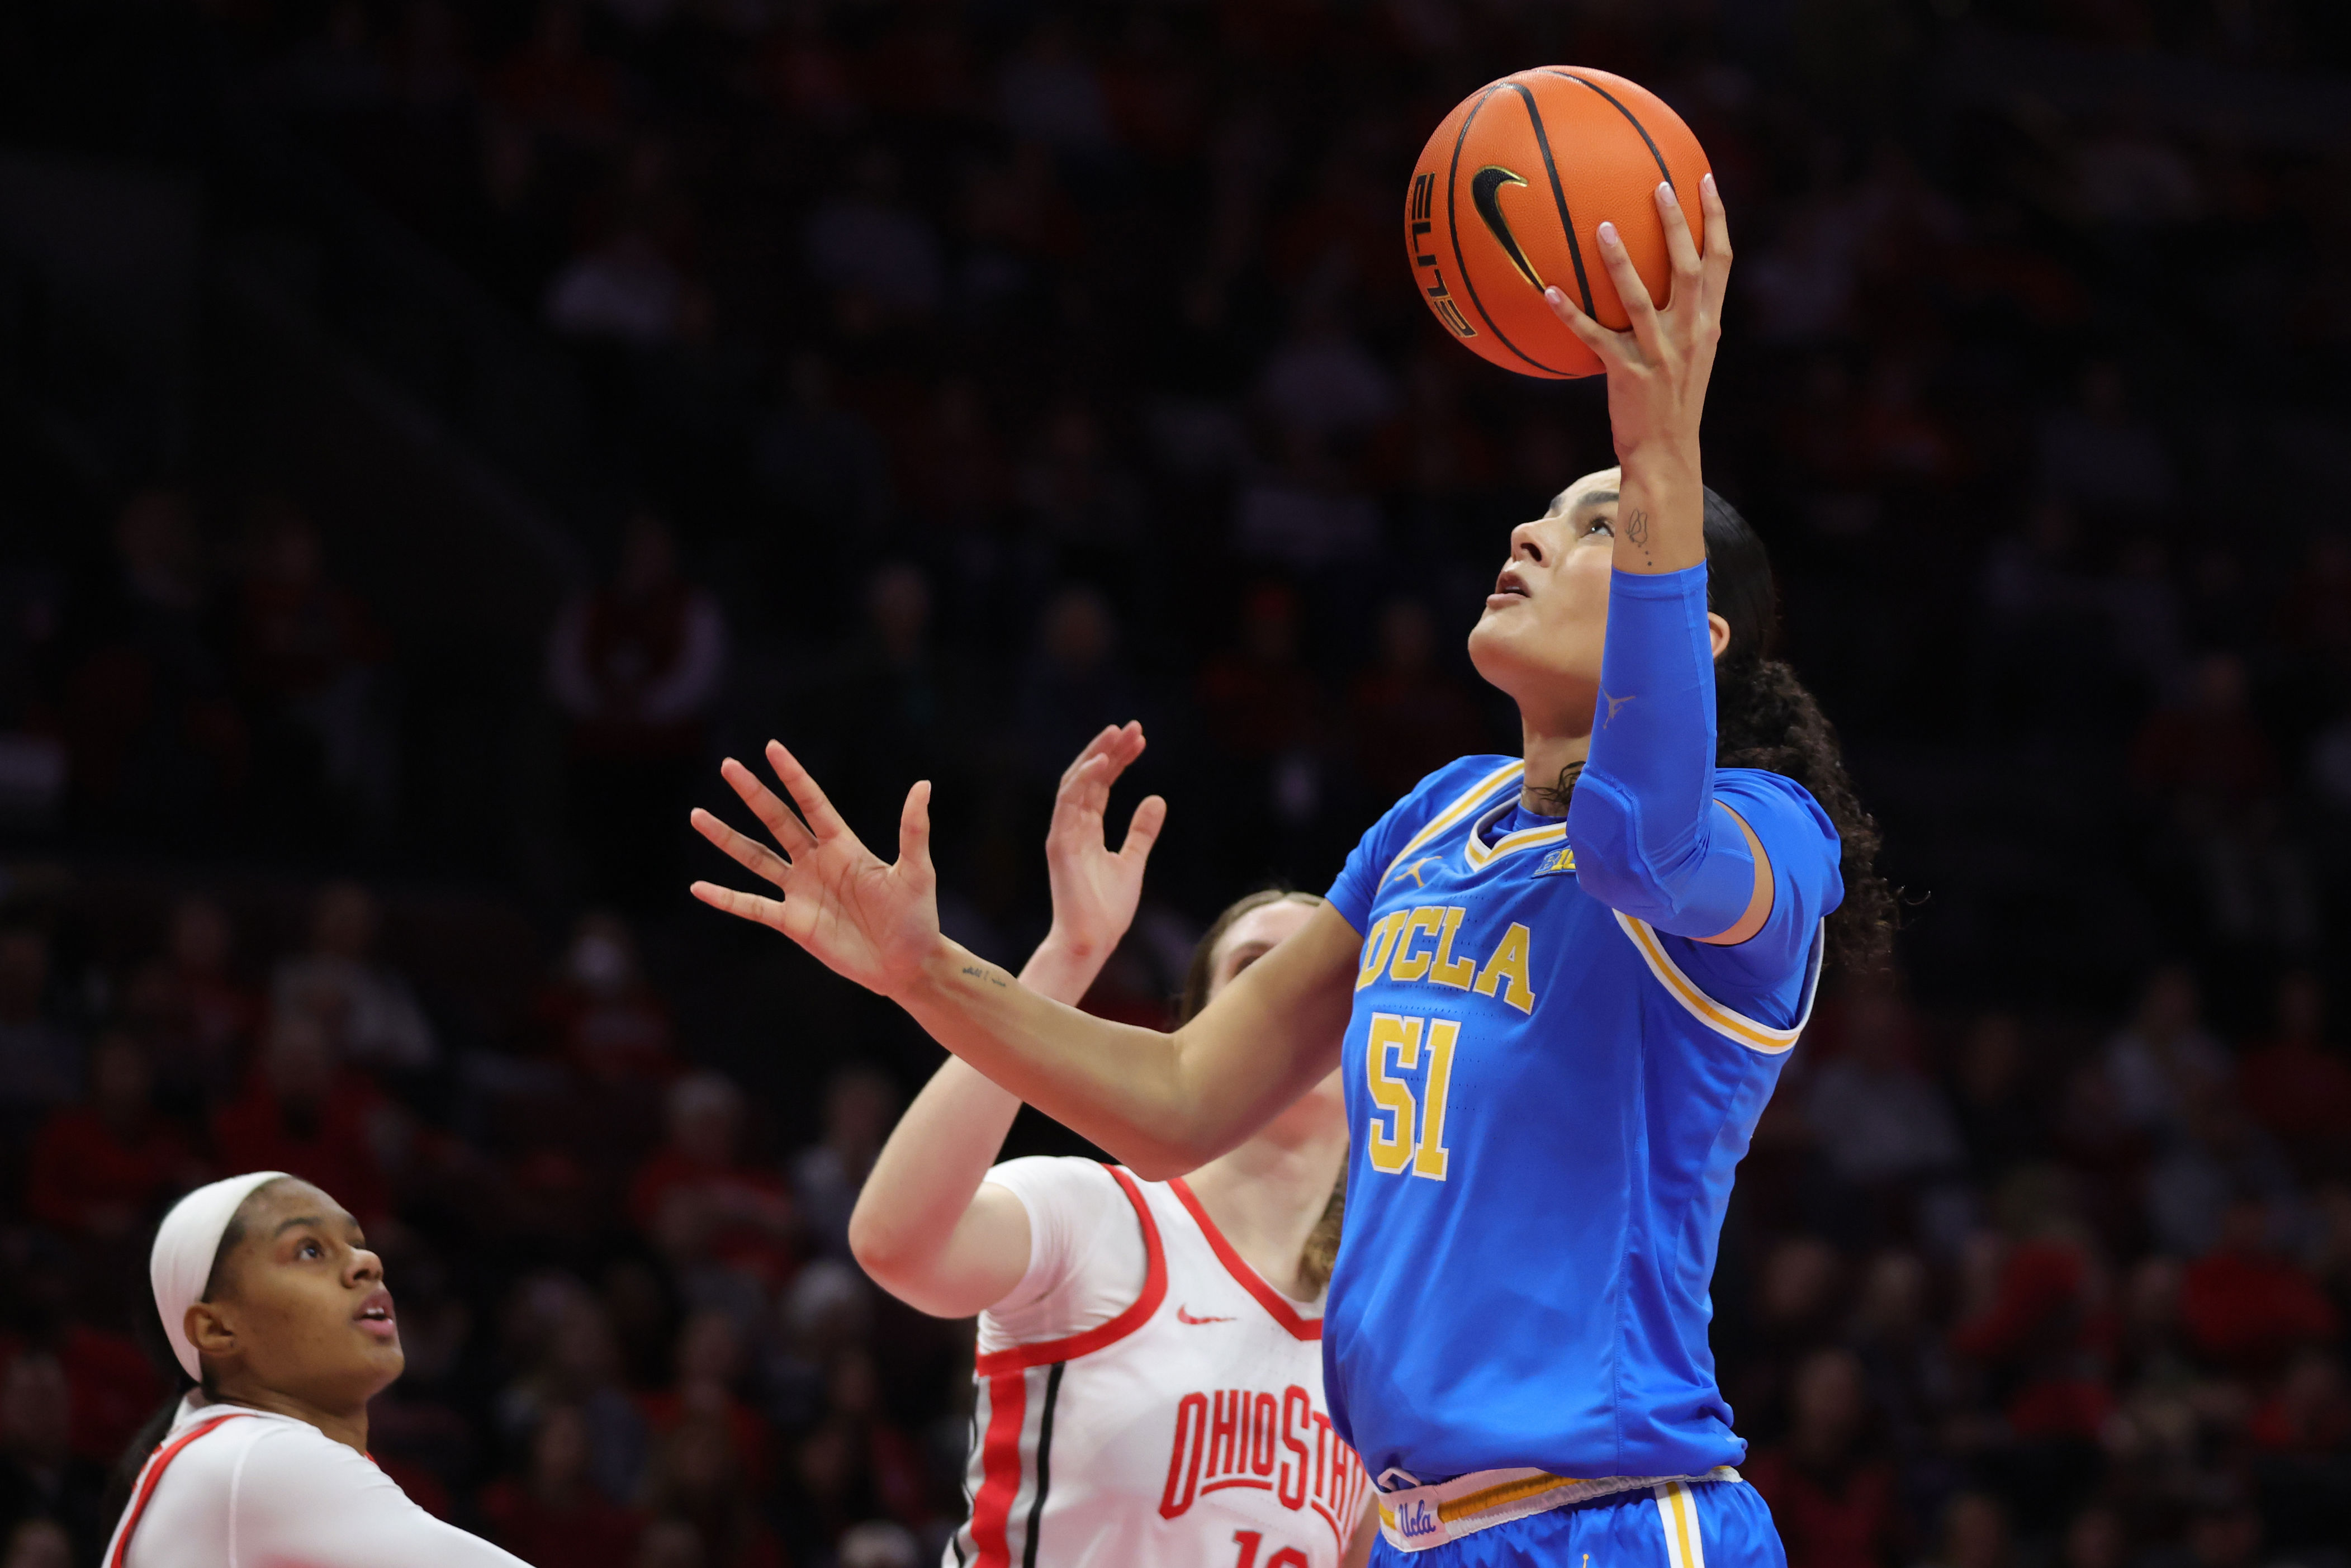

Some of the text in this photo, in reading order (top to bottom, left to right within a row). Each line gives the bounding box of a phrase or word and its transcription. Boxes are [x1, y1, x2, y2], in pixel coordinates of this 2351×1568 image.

[1411, 172, 1478, 338] ELITE
[1355, 905, 1535, 1015] UCLA
[1366, 1012, 1461, 1182] 51
[1158, 1390, 1277, 1520] OHIO
[1399, 1500, 1436, 1538] Ucla
